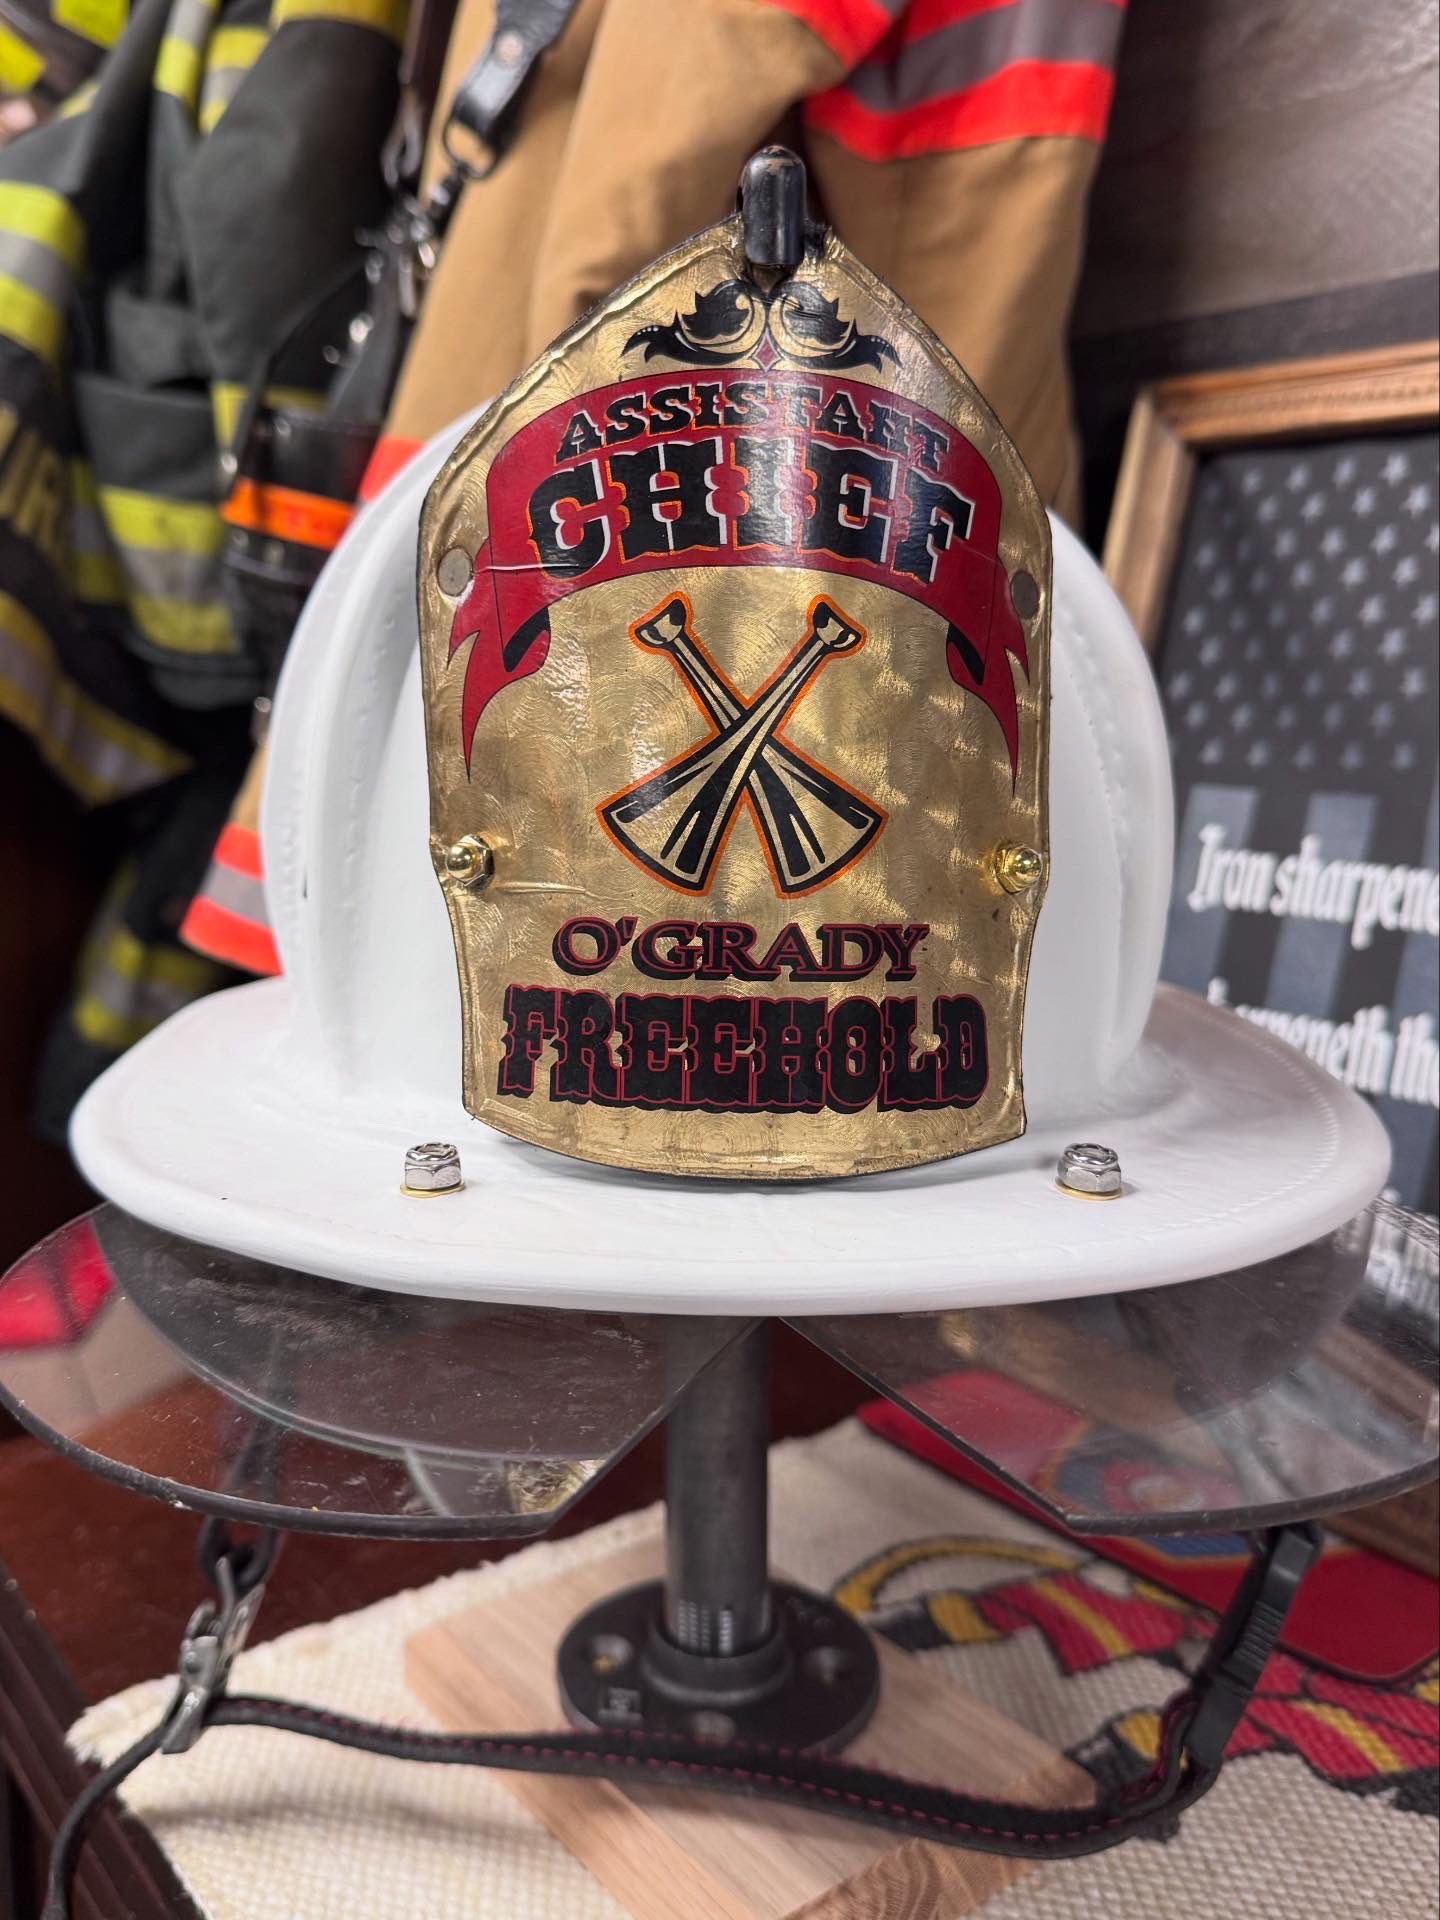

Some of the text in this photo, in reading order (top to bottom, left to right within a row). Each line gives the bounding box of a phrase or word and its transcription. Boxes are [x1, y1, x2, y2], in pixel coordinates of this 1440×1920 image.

[553, 381, 950, 473] ASSISTANT
[526, 436, 976, 584] CHIEF
[1187, 823, 1277, 913] Iron
[552, 916, 929, 982] O'GRADY
[497, 984, 990, 1114] FREEHOLD
